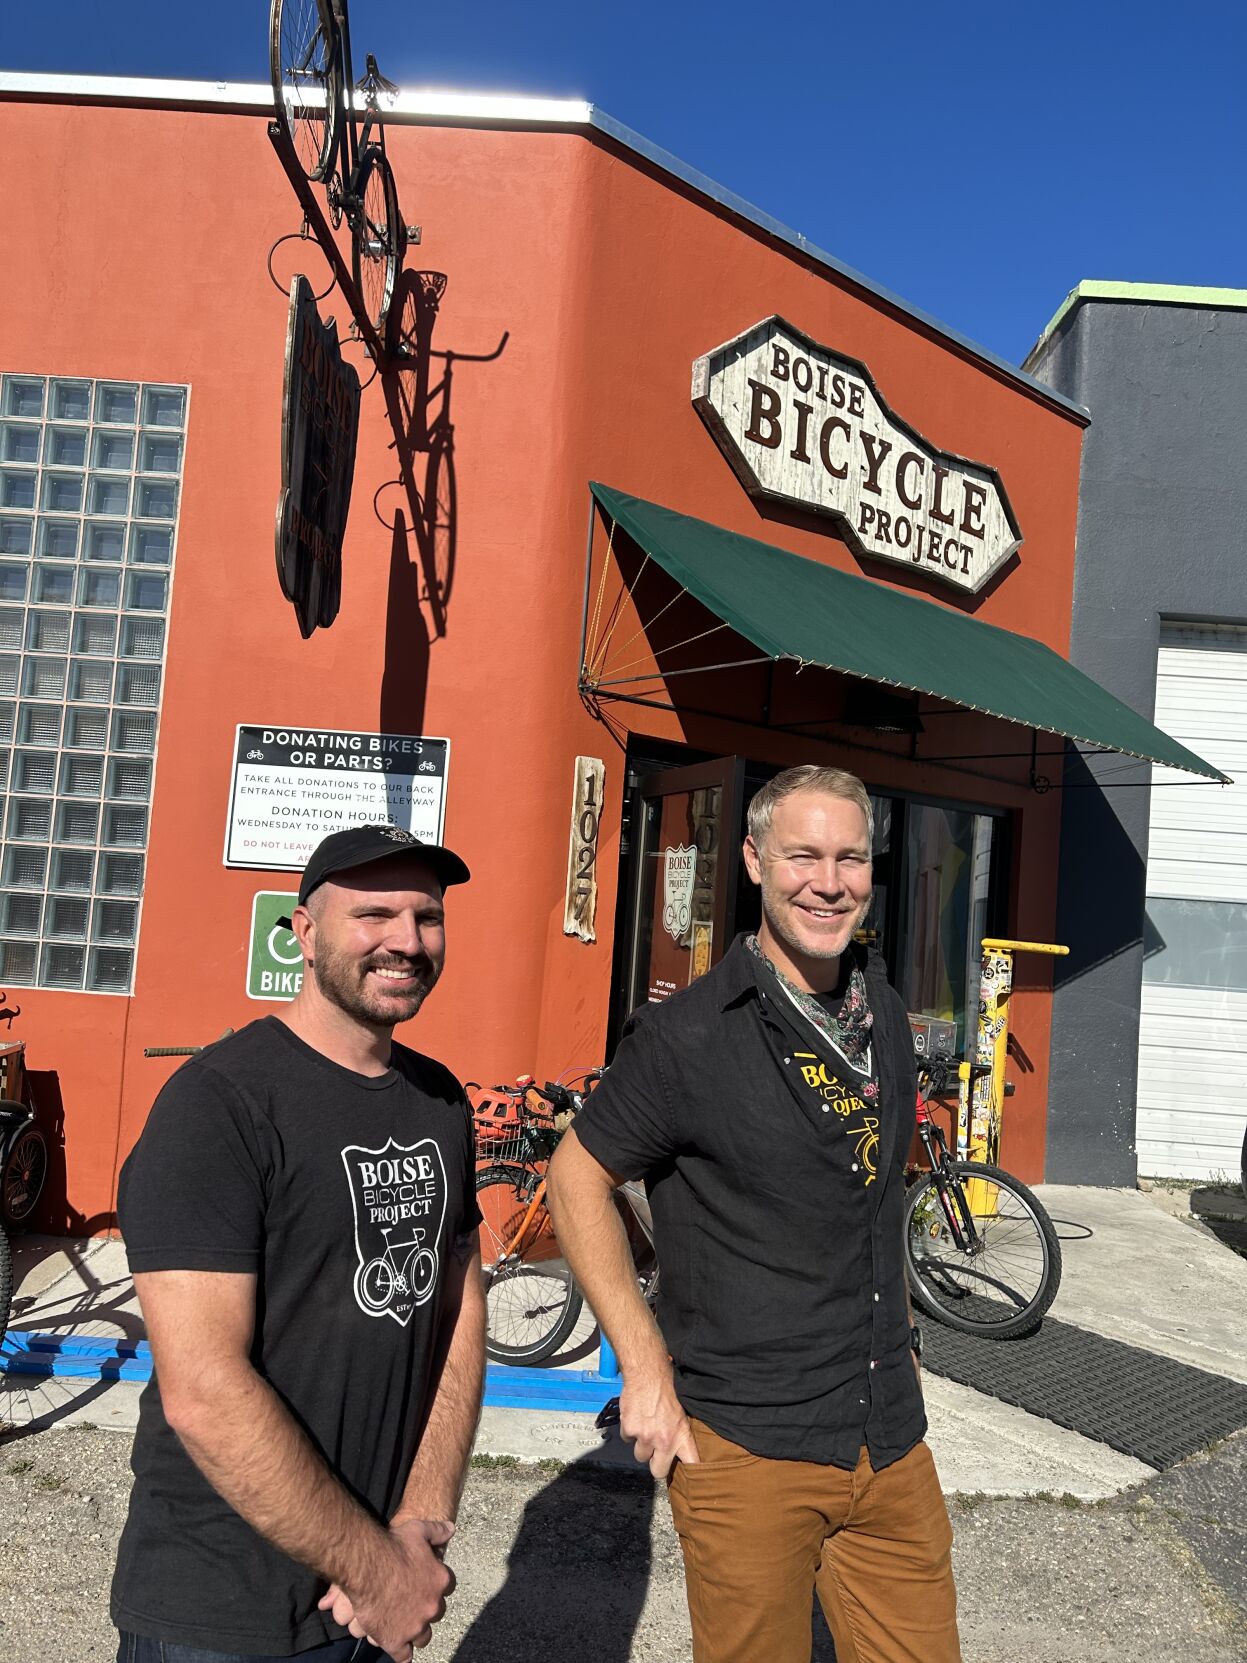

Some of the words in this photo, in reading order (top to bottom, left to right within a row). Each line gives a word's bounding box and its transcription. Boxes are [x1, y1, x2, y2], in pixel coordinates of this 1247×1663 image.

[770, 342, 865, 418] BOISE
[744, 378, 987, 540] BICYCLE
[858, 502, 974, 575] PROJECT
[262, 731, 362, 750] DONATING
[369, 738, 423, 754] BIKES
[290, 751, 316, 765] OR
[324, 753, 392, 770] PARTS?
[244, 774, 270, 783] TAKE
[274, 777, 293, 785] ALL
[297, 778, 359, 789] DONATIONS
[380, 784, 402, 792] OUR
[406, 785, 434, 794] BACK
[240, 786, 297, 797] ENTRANCE
[301, 790, 352, 800] THROUGH
[356, 794, 375, 802] THE
[379, 796, 435, 806] ALLEYWAY
[237, 818, 302, 830] WEDNESDAY
[306, 823, 319, 831] TO
[271, 806, 343, 819] DONATION
[348, 811, 398, 823] HOURS:
[243, 839, 257, 847] DO
[261, 841, 280, 849] NOT
[284, 842, 314, 851] LEAVE
[574, 773, 597, 920] 1027
[669, 856, 692, 870] BOISE
[669, 879, 689, 889] PROJECT
[261, 971, 304, 993] BIKE
[358, 1155, 435, 1188] BOISE
[364, 1181, 437, 1206] BICYCLE
[369, 1199, 432, 1225] PROJECT
